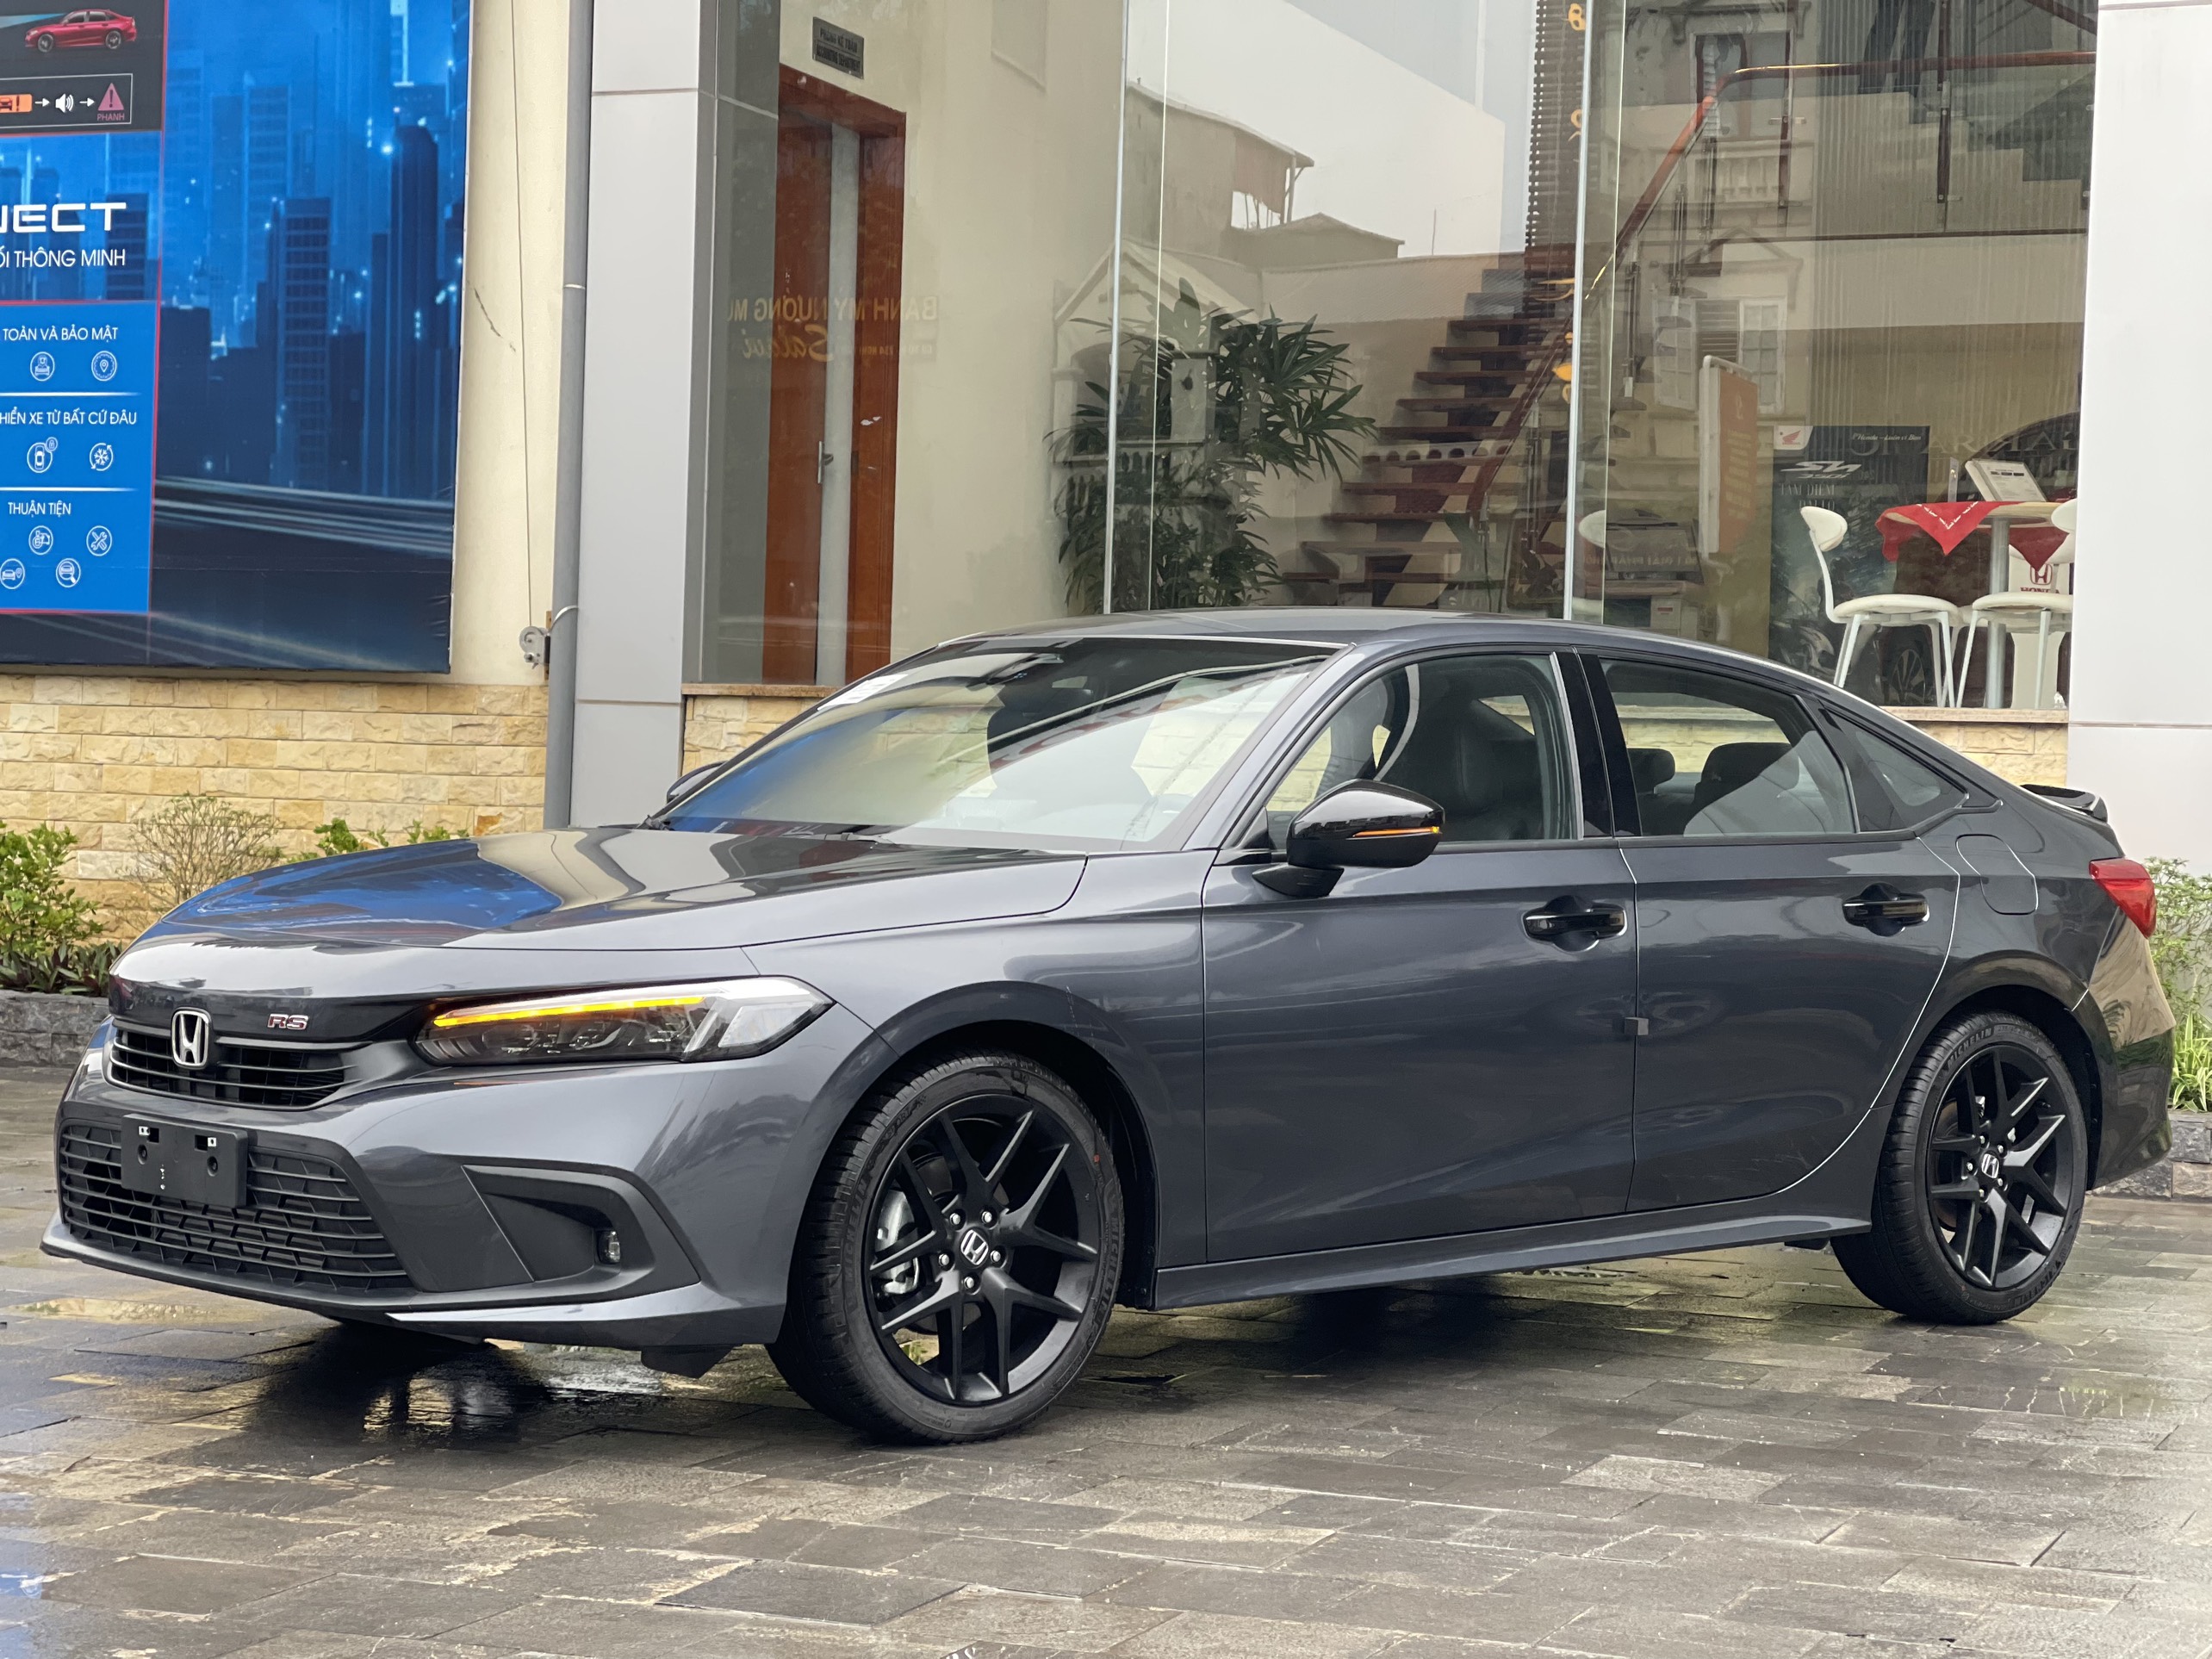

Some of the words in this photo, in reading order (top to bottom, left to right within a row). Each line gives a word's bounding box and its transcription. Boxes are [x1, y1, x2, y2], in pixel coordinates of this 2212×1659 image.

[96, 112, 125, 121] PHANH
[14, 246, 77, 268] THÔNG
[81, 248, 126, 266] MINH
[3, 326, 37, 341] TOÀN
[40, 326, 58, 341] VÀ
[61, 324, 89, 341] BẢO
[91, 325, 118, 343] MẬT
[28, 412, 44, 425] XE
[47, 408, 61, 425] TỪ
[63, 407, 85, 425] BẤT
[88, 409, 107, 425] CỨ
[109, 409, 137, 425] ĐÂU
[8, 500, 46, 518] THUẬN
[47, 500, 71, 518] TIỆN
[267, 1013, 308, 1030] RS
[1947, 1027, 1992, 1069] MICHELIN
[843, 1177, 871, 1282] MICHELIN
[1097, 1216, 1120, 1309] MICHELIN
